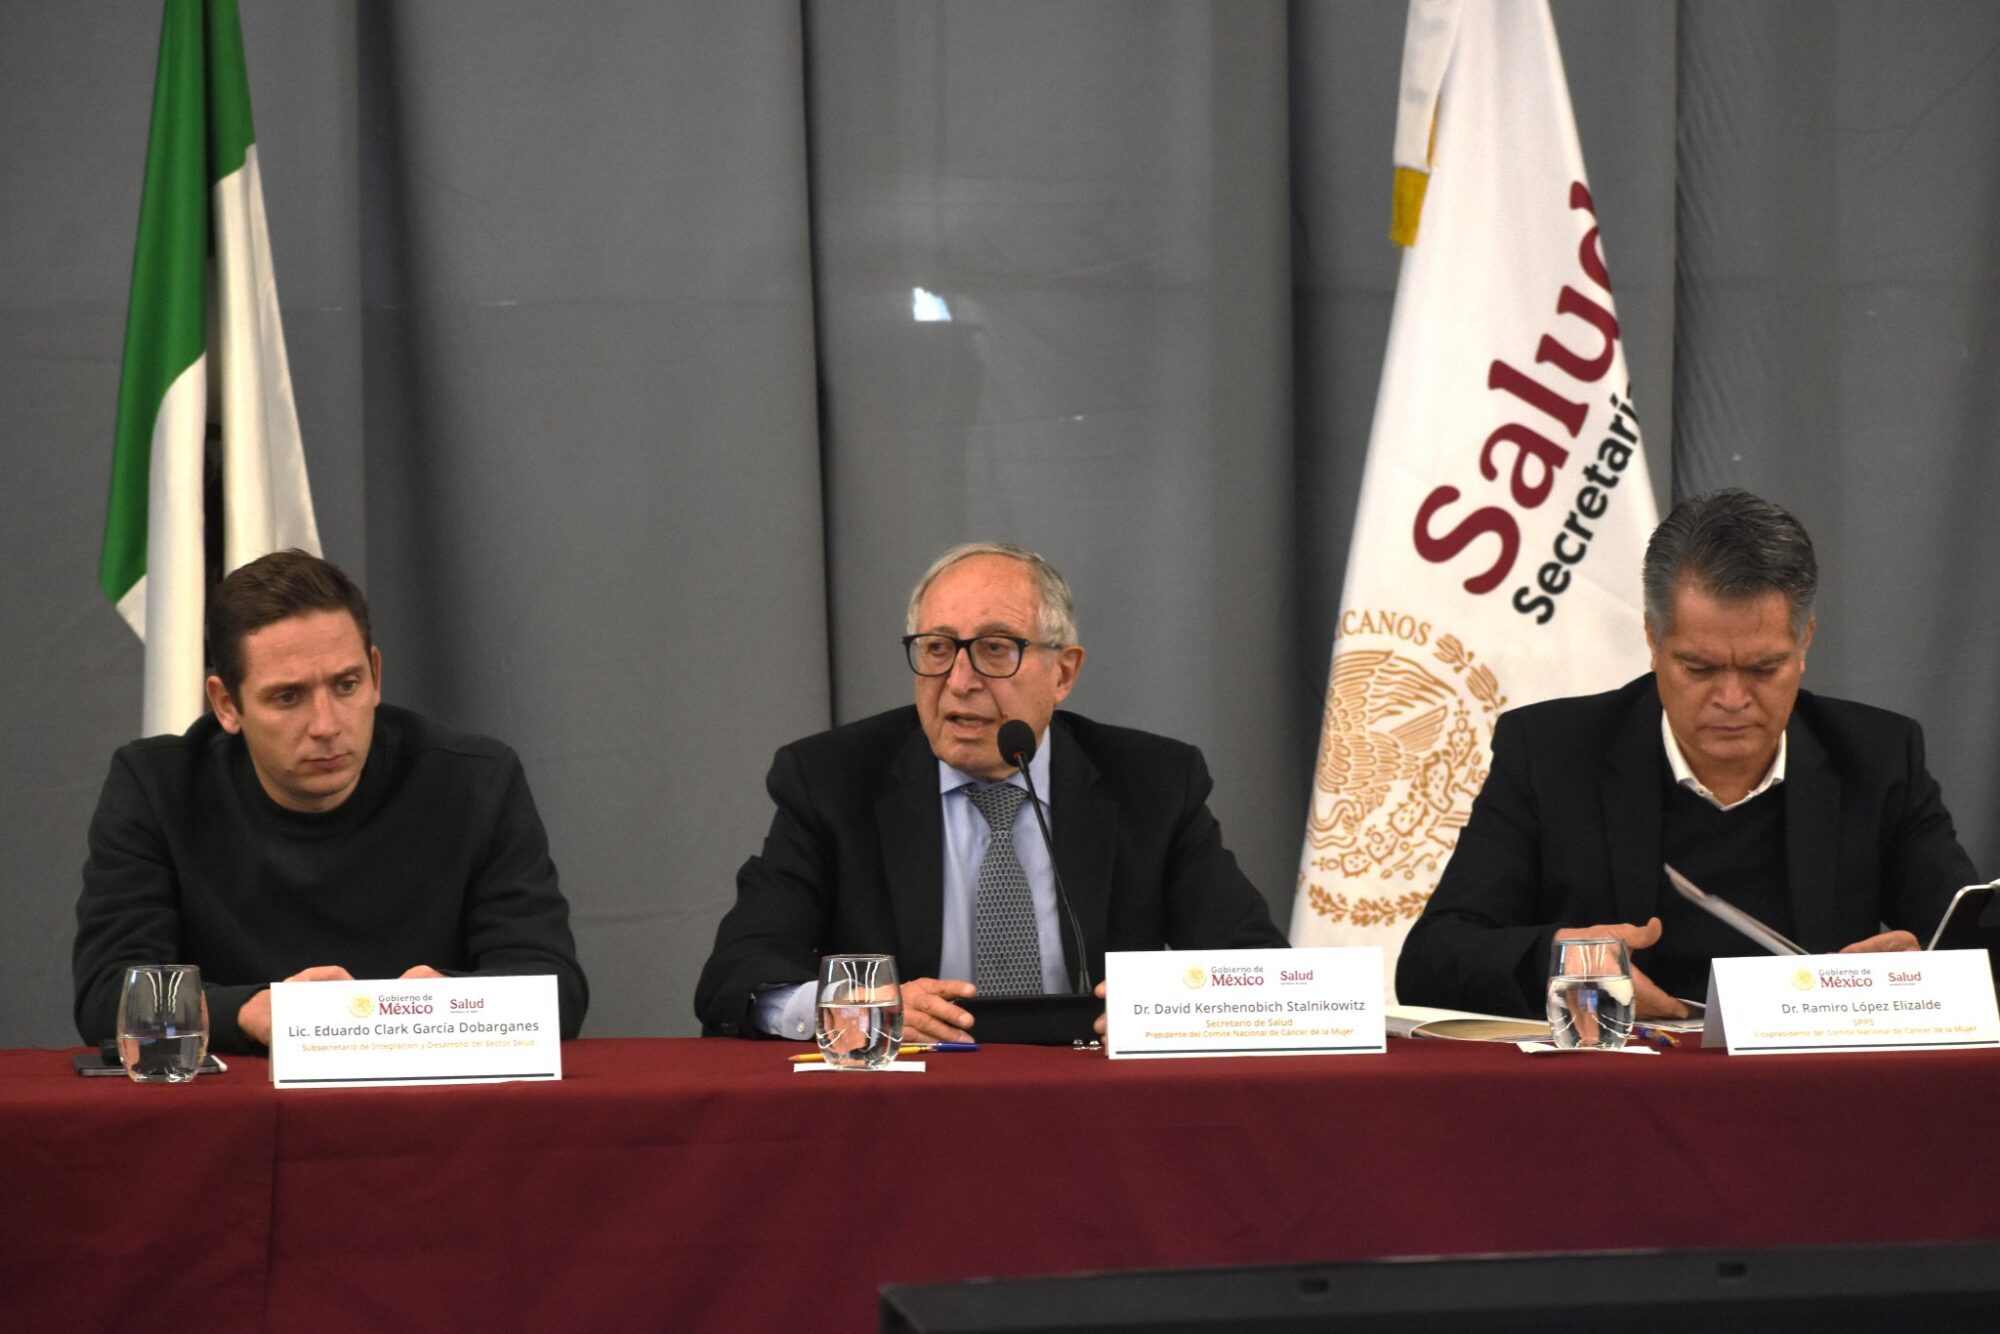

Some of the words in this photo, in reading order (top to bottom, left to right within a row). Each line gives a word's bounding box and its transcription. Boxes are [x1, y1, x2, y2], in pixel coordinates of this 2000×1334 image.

[1512, 381, 1641, 625] Secretarí
[1336, 609, 1432, 646] CANOS
[1253, 965, 1264, 973] de
[1211, 973, 1264, 987] México
[1280, 970, 1314, 981] Salud
[1888, 971, 1922, 982] Salud
[1820, 976, 1873, 988] México
[378, 994, 420, 1002] Gobierno
[450, 998, 484, 1010] Salud
[379, 1002, 433, 1015] México
[1134, 1004, 1150, 1015] Dr.
[1154, 1003, 1191, 1014] David
[1195, 1001, 1283, 1014] Kershenobich
[1287, 1000, 1365, 1012] Stalnikowitz
[1781, 1003, 1799, 1014] Dr.
[1802, 1003, 1848, 1013] Ramiro
[1852, 1001, 1889, 1014] López
[1893, 1000, 1941, 1011] Elizalde
[288, 1026, 310, 1037] Lic.
[314, 1025, 370, 1037] Eduardo
[374, 1023, 408, 1035] Clark
[413, 1022, 455, 1034] García
[459, 1021, 539, 1035] Dobarganes
[1206, 1019, 1251, 1028] Secretario
[1254, 1019, 1265, 1027] de
[1268, 1018, 1293, 1027] Salud
[1145, 1031, 1186, 1039] Presidente
[1269, 1029, 1279, 1037] de
[1310, 1028, 1320, 1036] de
[1331, 1027, 1354, 1037] Mujer
